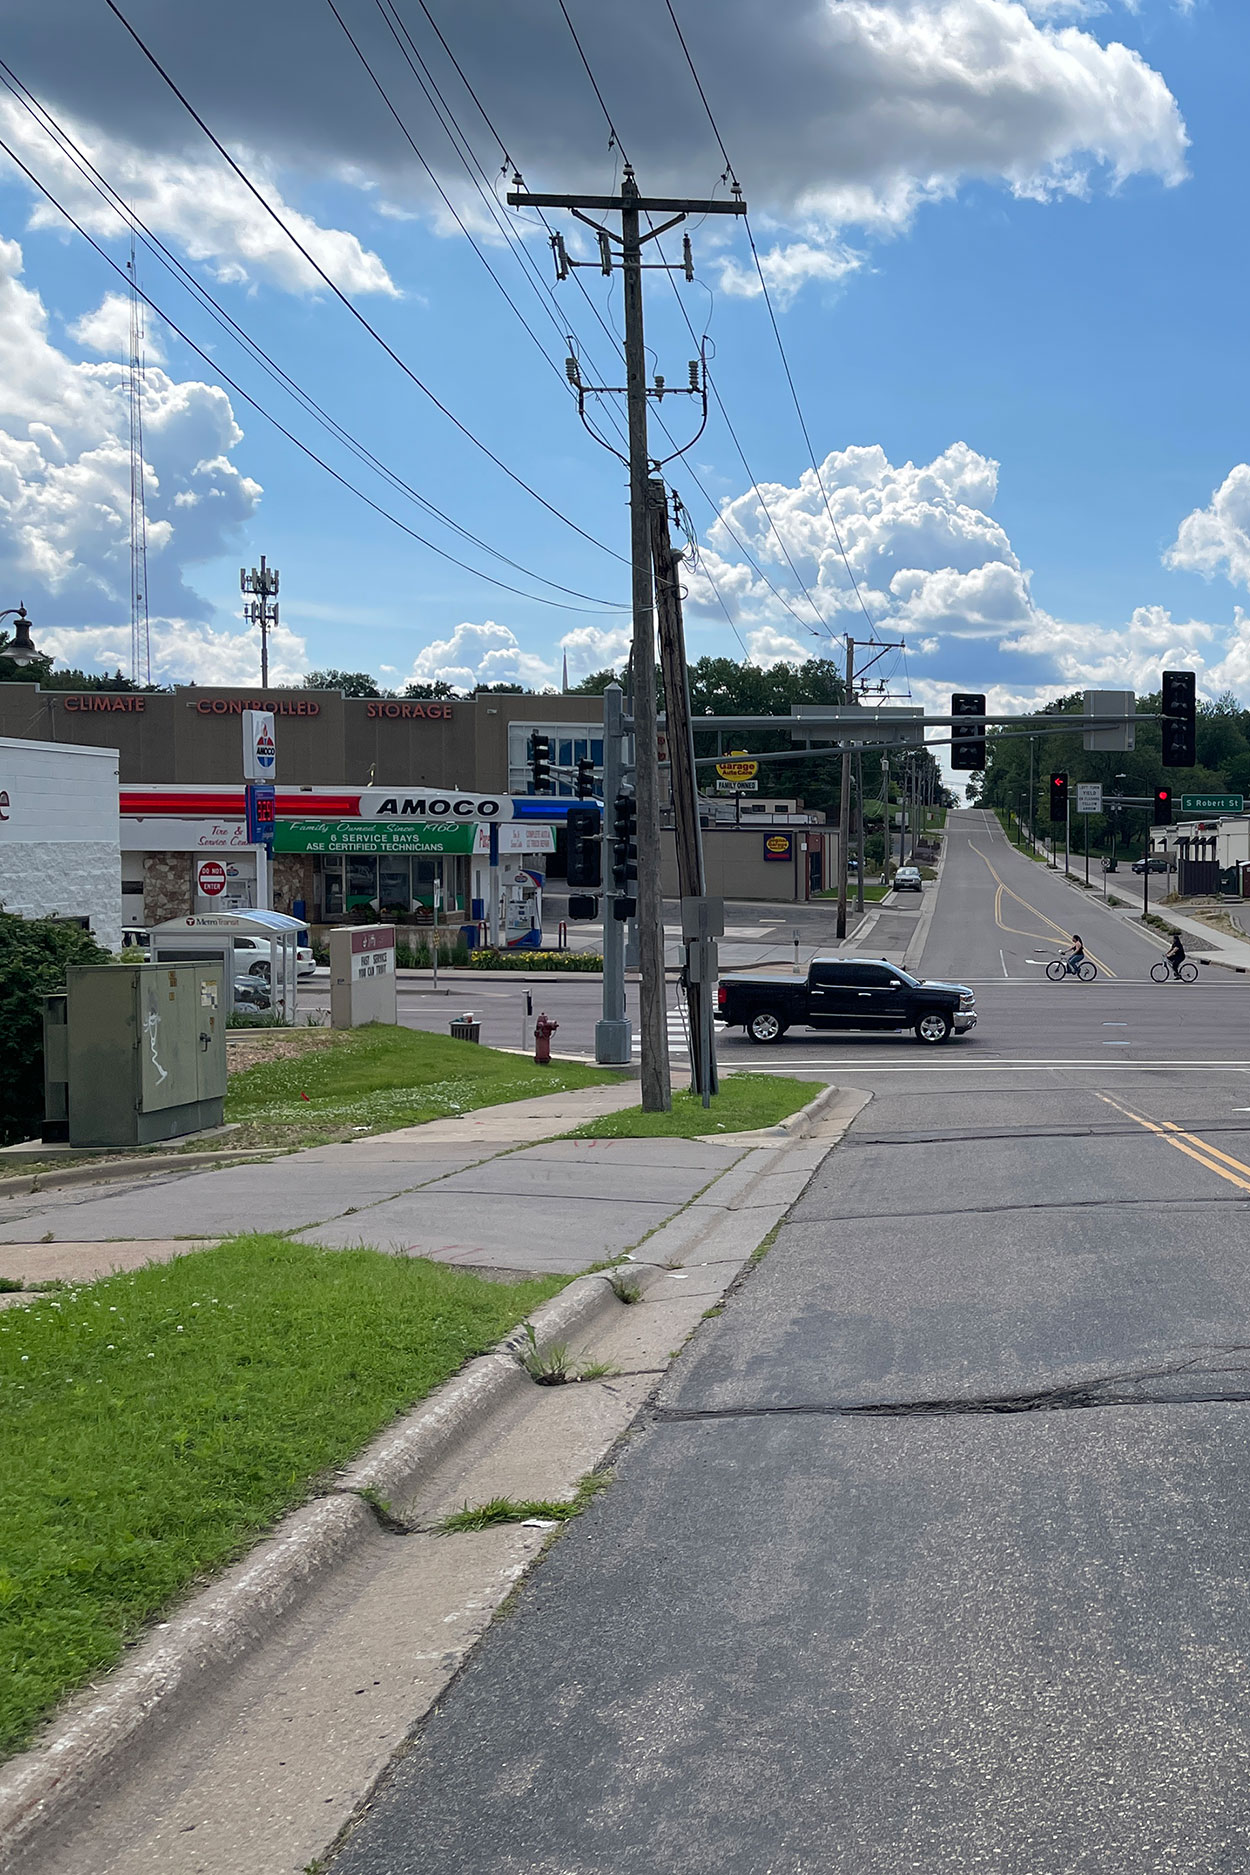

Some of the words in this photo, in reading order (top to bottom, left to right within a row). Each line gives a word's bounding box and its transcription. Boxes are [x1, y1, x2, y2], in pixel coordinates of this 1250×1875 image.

[64, 696, 145, 712] CLIMATE
[197, 700, 320, 716] CONTROLLED
[367, 703, 452, 719] STORAGE
[256, 747, 276, 756] AMOCO
[719, 781, 737, 789] FAMILY
[737, 781, 756, 789] OWNED
[376, 798, 500, 816] AMOCO
[1196, 799, 1225, 807] Robert
[1229, 799, 1239, 807] St
[234, 826, 243, 835] &
[290, 822, 329, 833] Family
[336, 823, 376, 833] Owned
[384, 823, 415, 833] Since
[422, 823, 460, 833] 1960
[330, 834, 337, 842] 6
[342, 834, 388, 842] SERVICE
[393, 834, 420, 842] BAYS
[306, 843, 326, 851] ASE
[328, 843, 378, 851] CERTIFIED
[380, 843, 444, 851] TECHNICIANS
